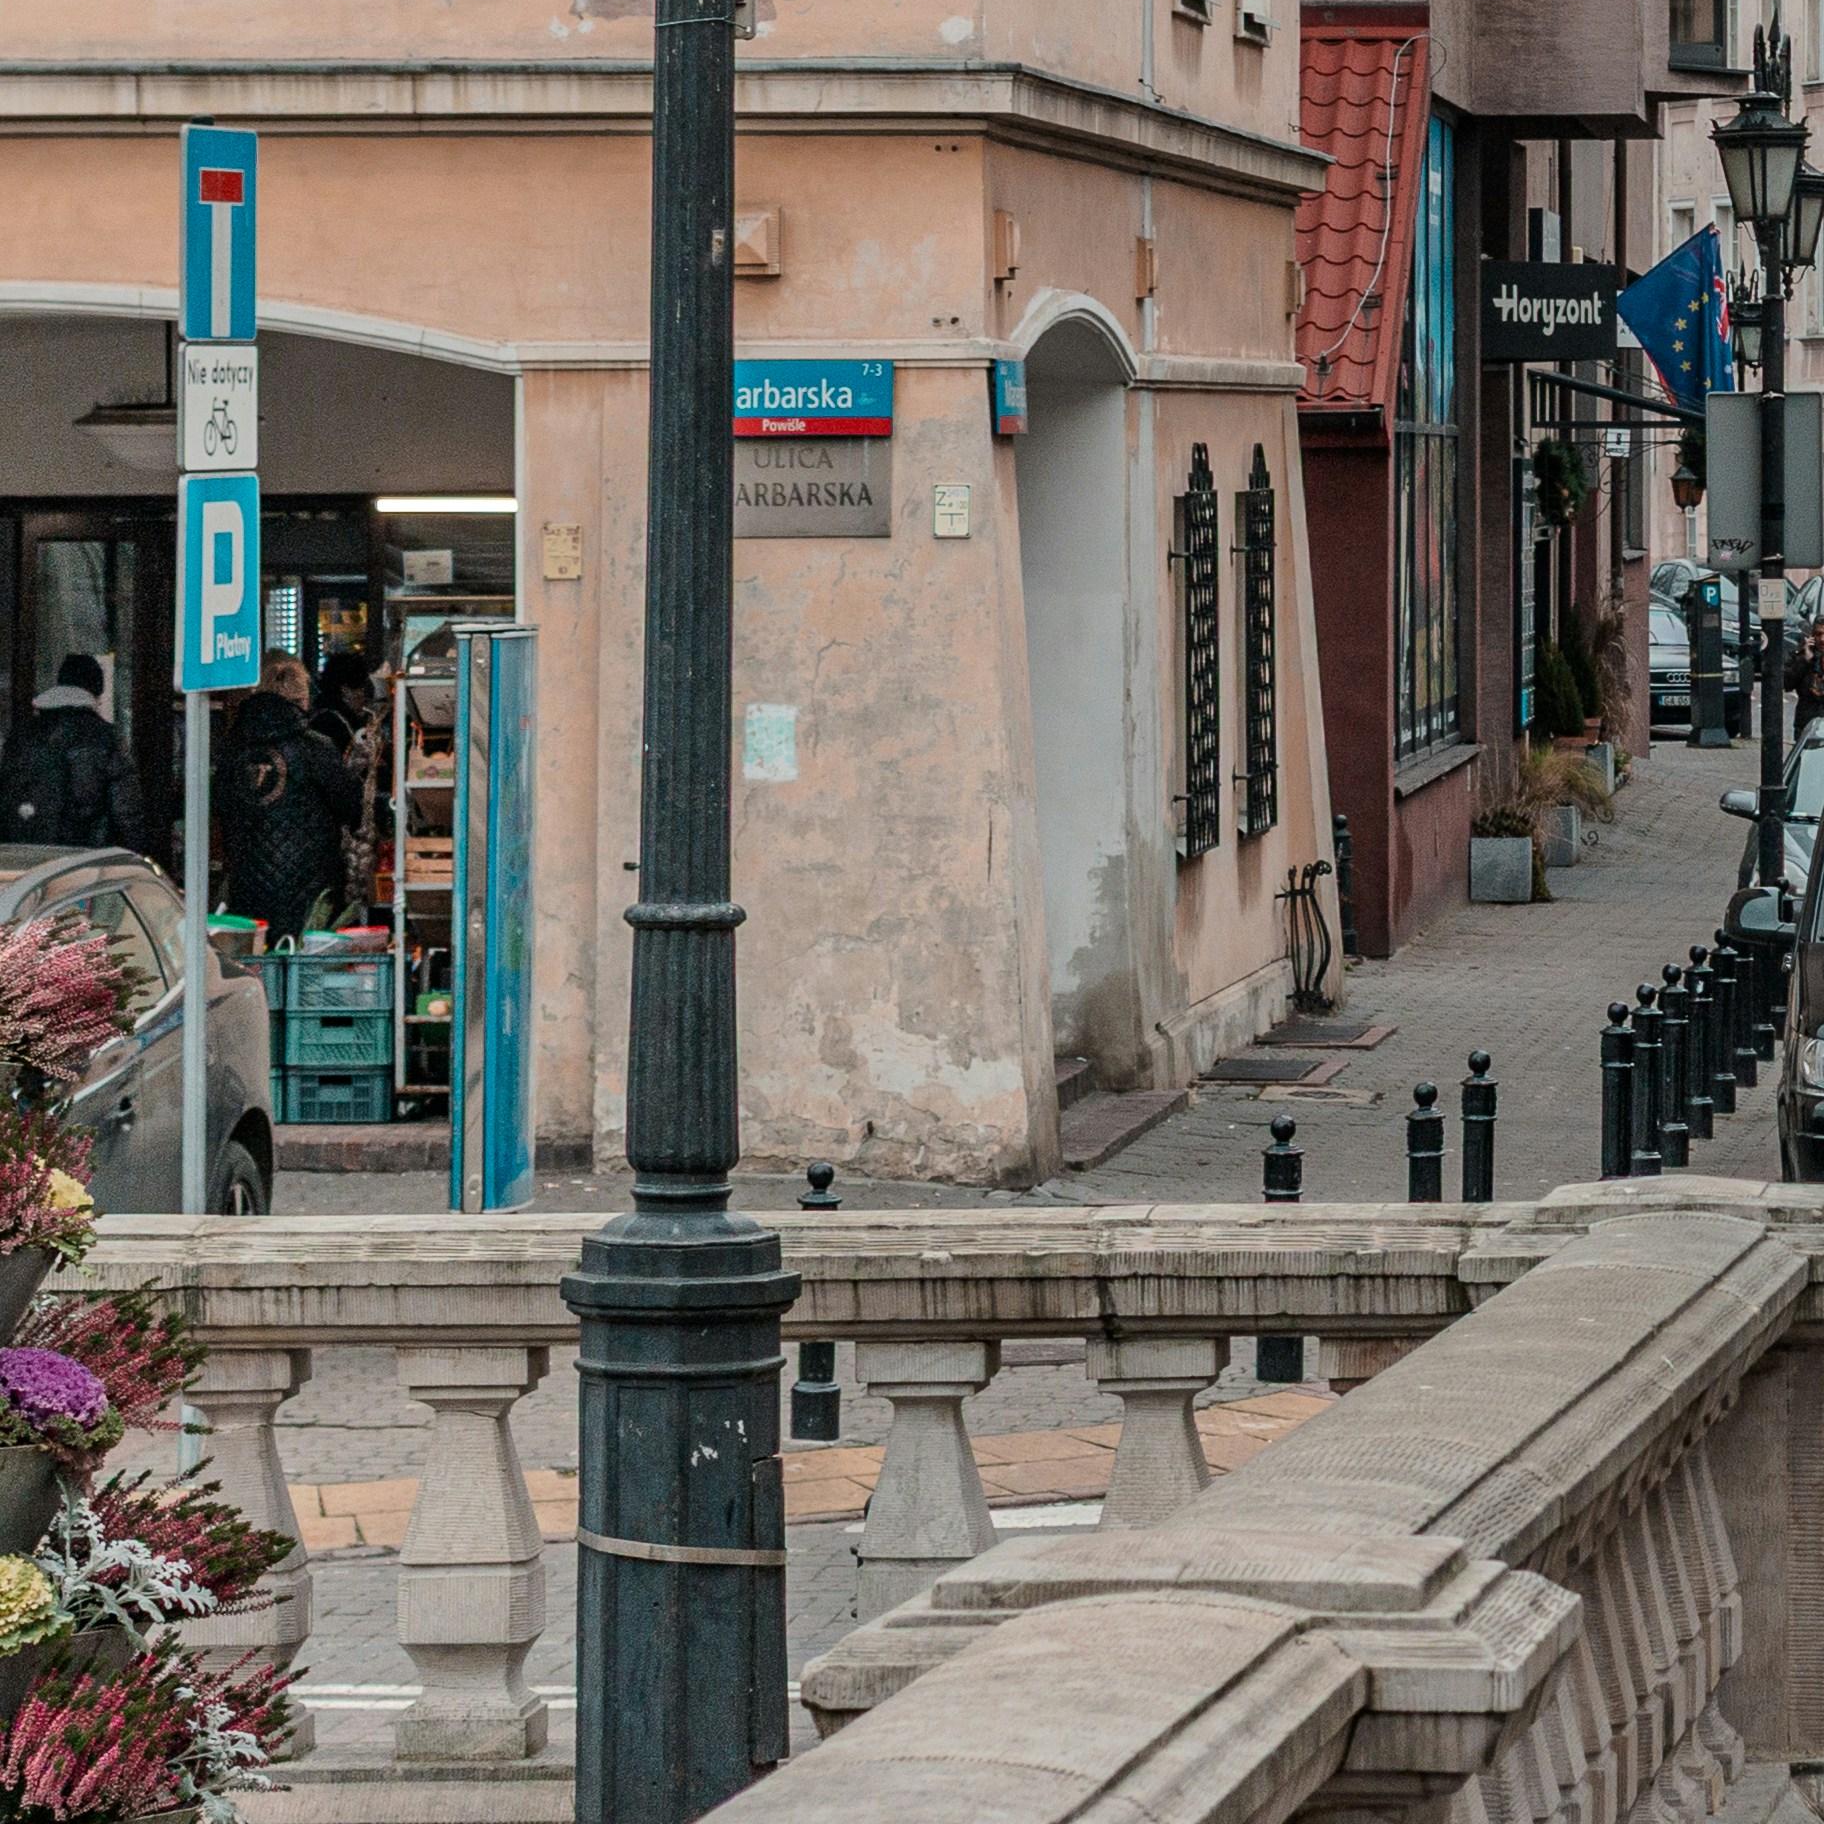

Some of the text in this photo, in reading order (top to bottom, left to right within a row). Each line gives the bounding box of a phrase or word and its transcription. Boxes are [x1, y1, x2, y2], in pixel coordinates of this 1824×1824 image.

[1492, 284, 1602, 337] Horyzont
[187, 359, 254, 392] Nie dotyczy
[862, 363, 883, 376] 7-3
[735, 378, 853, 409] arbarska
[762, 418, 807, 432] Powiśle
[753, 448, 834, 469] ULICA
[735, 482, 873, 507] ARBARSKA
[1706, 586, 1716, 602] P
